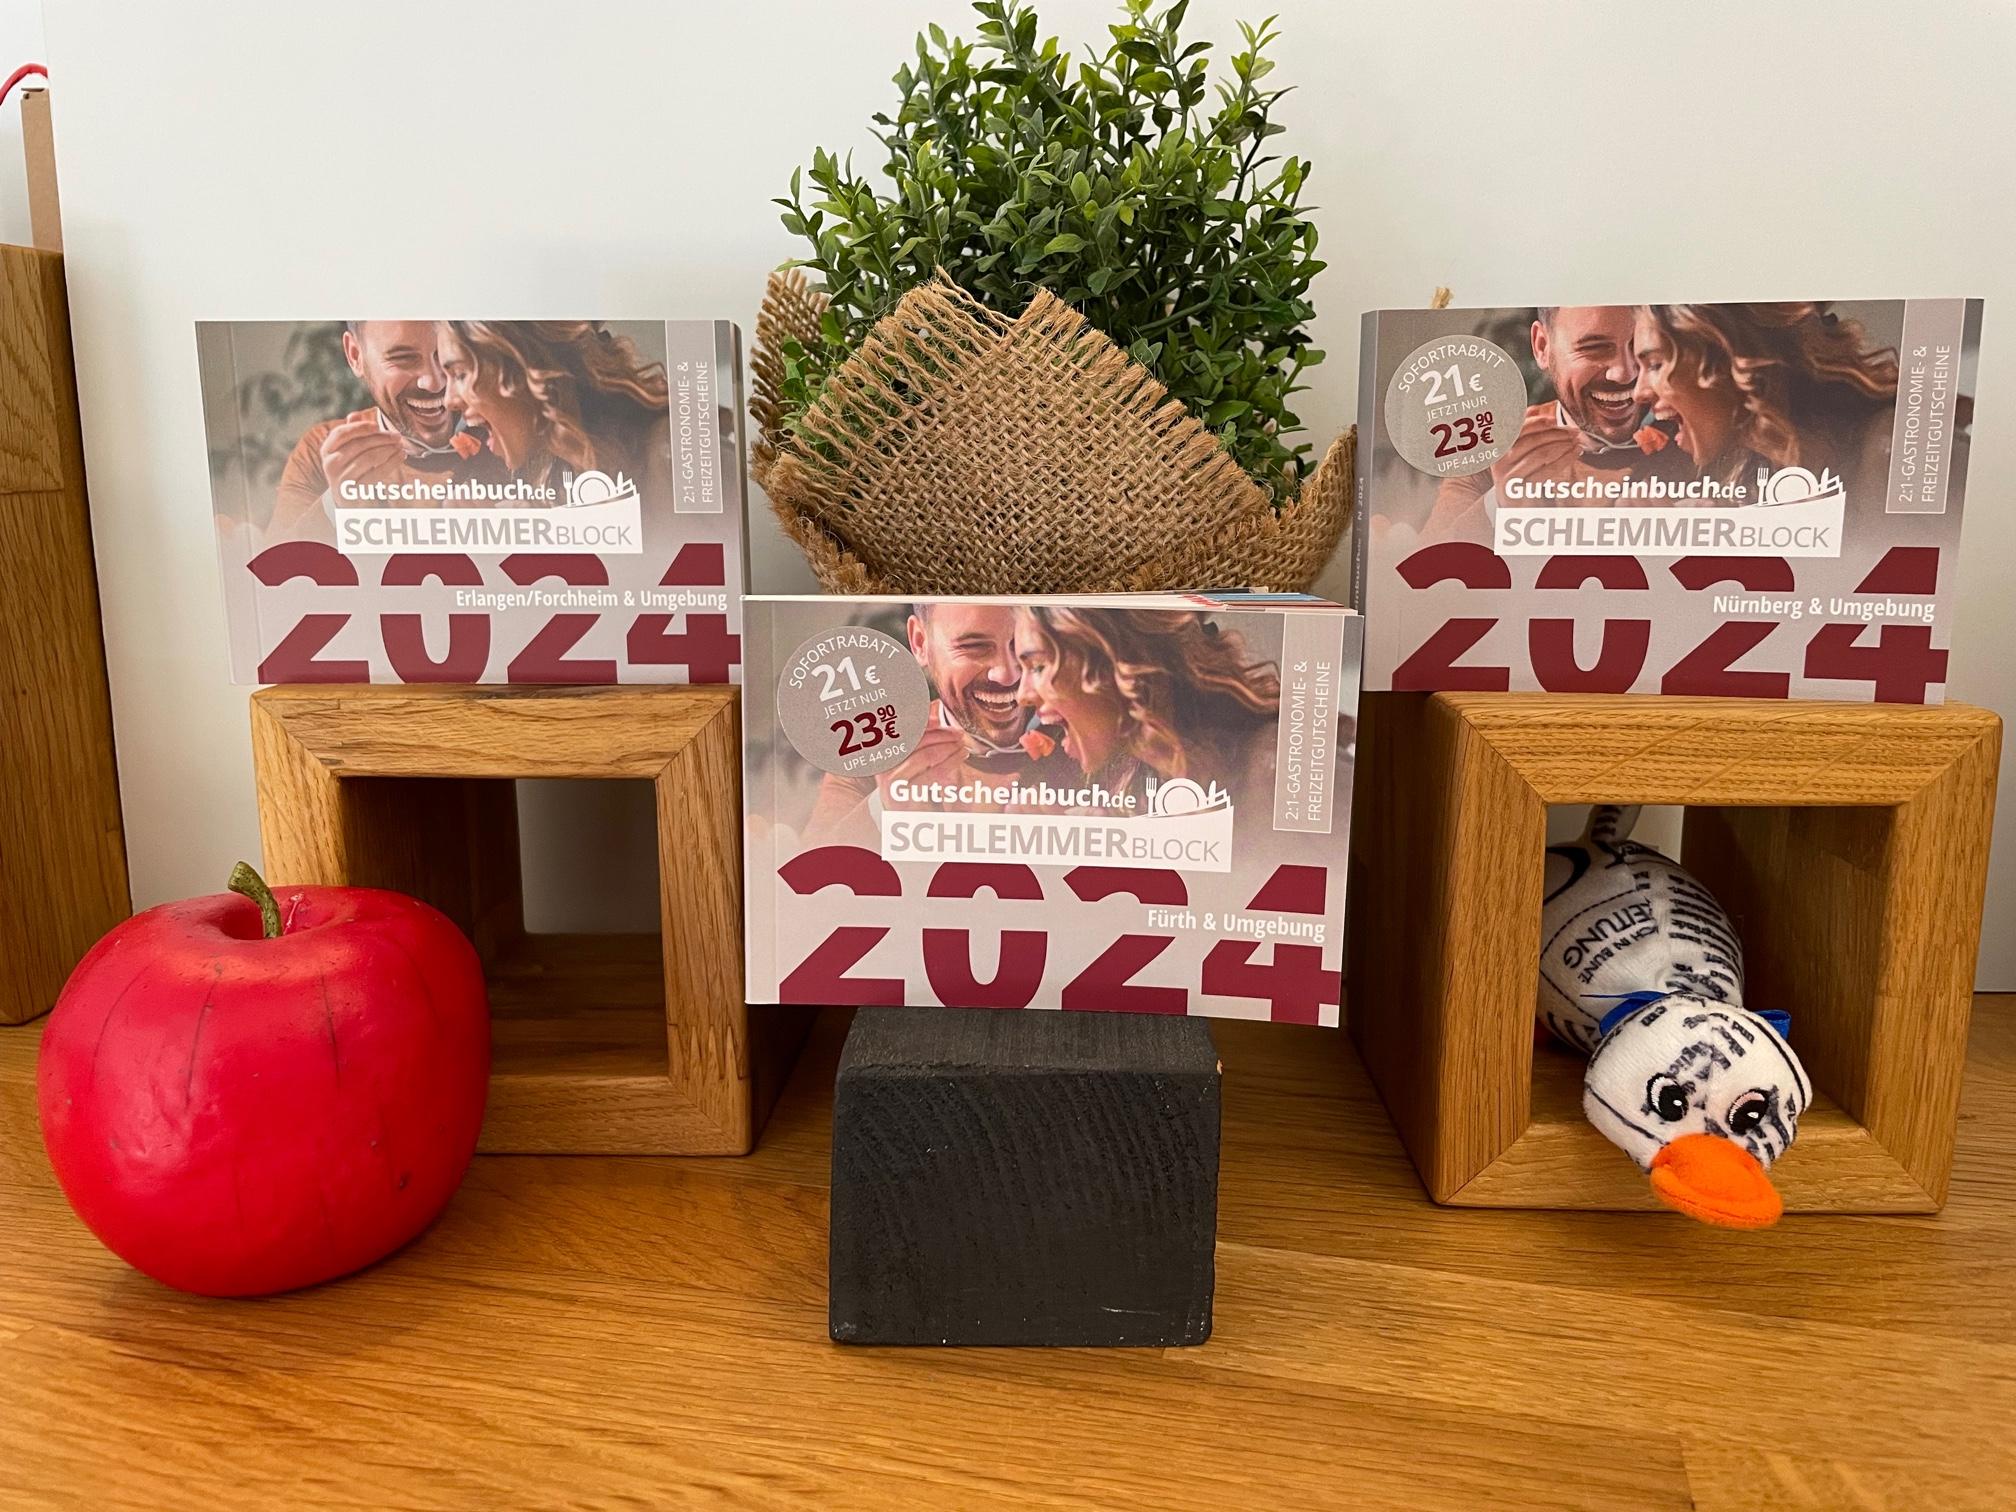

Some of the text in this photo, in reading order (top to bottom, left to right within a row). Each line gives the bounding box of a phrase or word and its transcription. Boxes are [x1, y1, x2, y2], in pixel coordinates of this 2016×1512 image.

[1398, 344, 1505, 393] SOFORTRABATT
[1419, 363, 1465, 406] 21
[677, 361, 695, 503] 2:1-GASTRONOMIE- &
[696, 361, 713, 503] FREIZEITGUTSCHEINE
[1427, 395, 1488, 423] JETZT NUR
[1899, 346, 1927, 503] 2:1-GASTRONOMIE- &
[1922, 345, 1950, 502] FREIZEITGUTSCHEINE
[1437, 459, 1459, 473] UPE
[1504, 476, 1747, 501] Gutscheinbuch.de
[340, 478, 557, 501] Gutscheinbuch.de
[246, 541, 741, 685] 2024
[456, 589, 727, 612] Erlangen/Forchheim & Umgebung
[1391, 541, 1950, 705] 2024
[1713, 595, 1936, 623] Nürnberg & Umgebung
[789, 634, 900, 689] SOFORTRABATT
[811, 656, 862, 702] 21
[824, 688, 888, 719] JETZT NUR
[1285, 660, 1308, 820] 2:1-GASTRONOMIE- &
[1308, 661, 1330, 821] FREIZEITGUTSCHEINE
[843, 757, 867, 771] UPE
[889, 779, 1136, 809] Gutscheinbuch.de
[777, 845, 1341, 1027] 2024
[1147, 909, 1326, 942] Fürth & Umgebung
